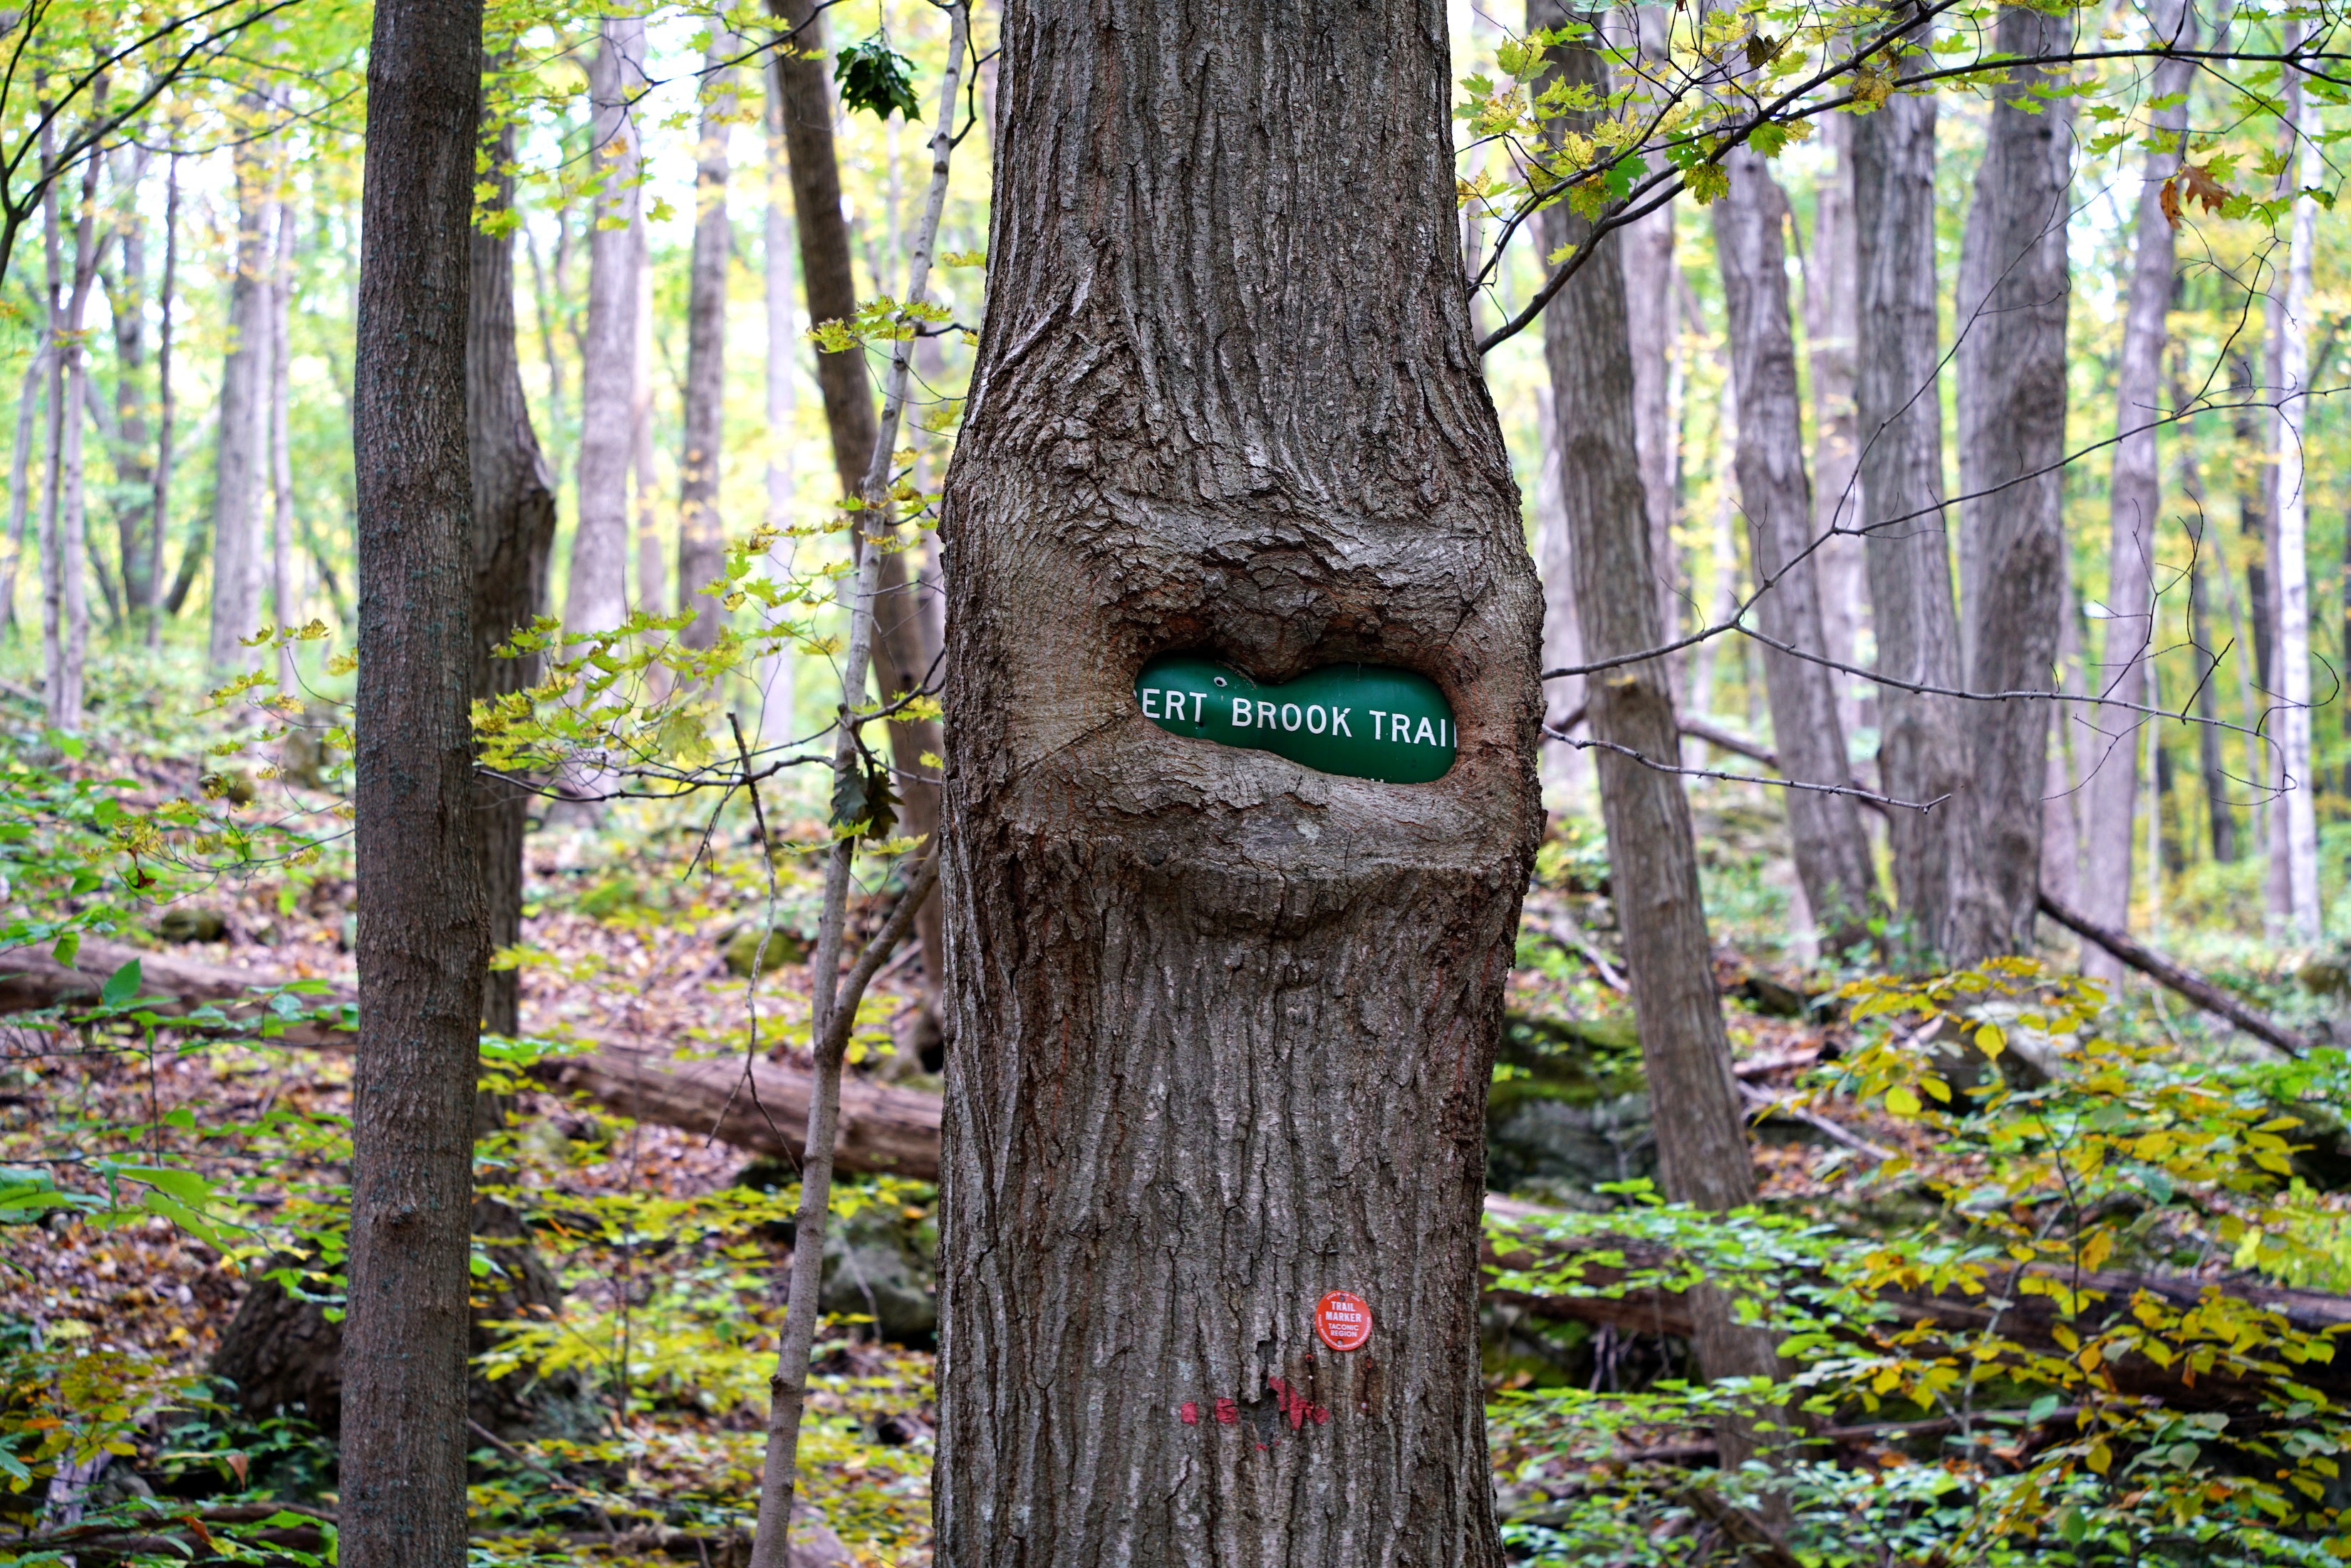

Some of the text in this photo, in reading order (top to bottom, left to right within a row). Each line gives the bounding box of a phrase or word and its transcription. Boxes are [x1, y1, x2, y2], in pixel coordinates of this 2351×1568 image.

[1133, 687, 1208, 723] ERT
[1232, 697, 1352, 738] BROOK
[1331, 1301, 1356, 1312] TRAIL
[1325, 1311, 1361, 1322] MARKER
